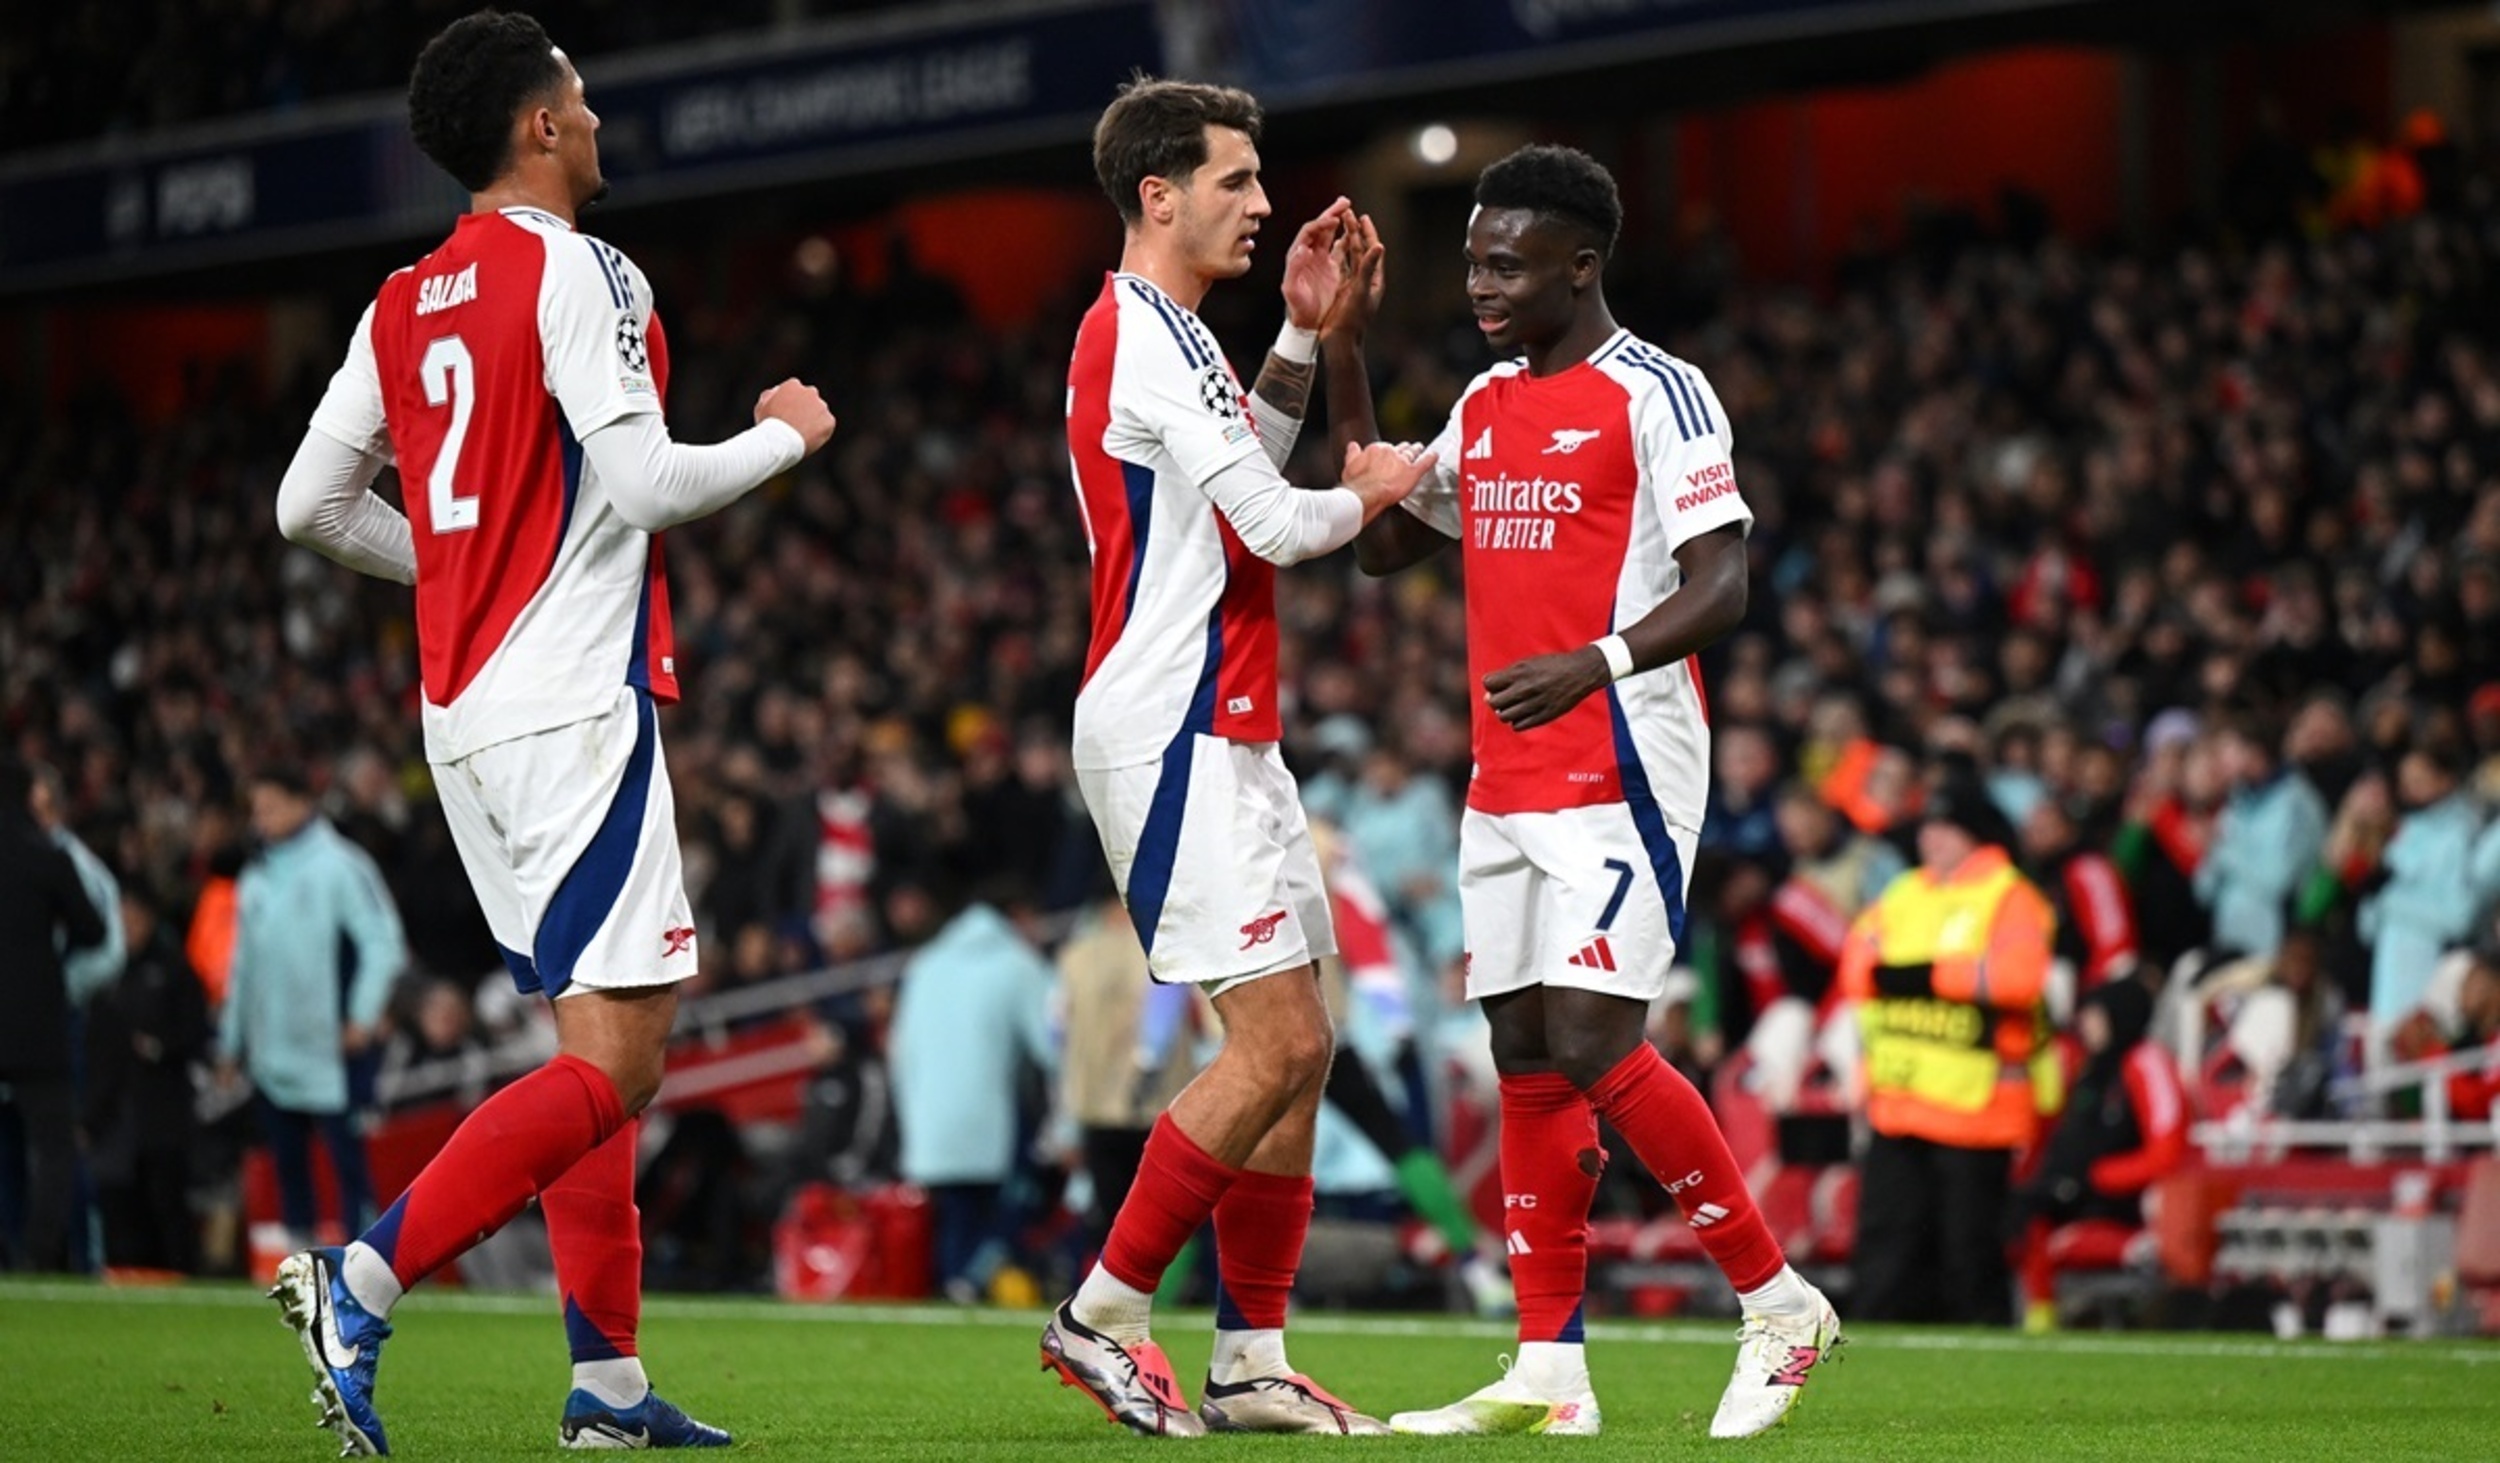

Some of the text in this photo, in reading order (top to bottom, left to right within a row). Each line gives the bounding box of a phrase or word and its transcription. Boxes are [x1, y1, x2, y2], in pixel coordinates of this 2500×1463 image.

[416, 261, 478, 316] SALIBA
[419, 334, 479, 535] 2
[1686, 462, 1730, 487] VISIT
[1491, 517, 1556, 550] BETTER
[1594, 857, 1635, 932] 7
